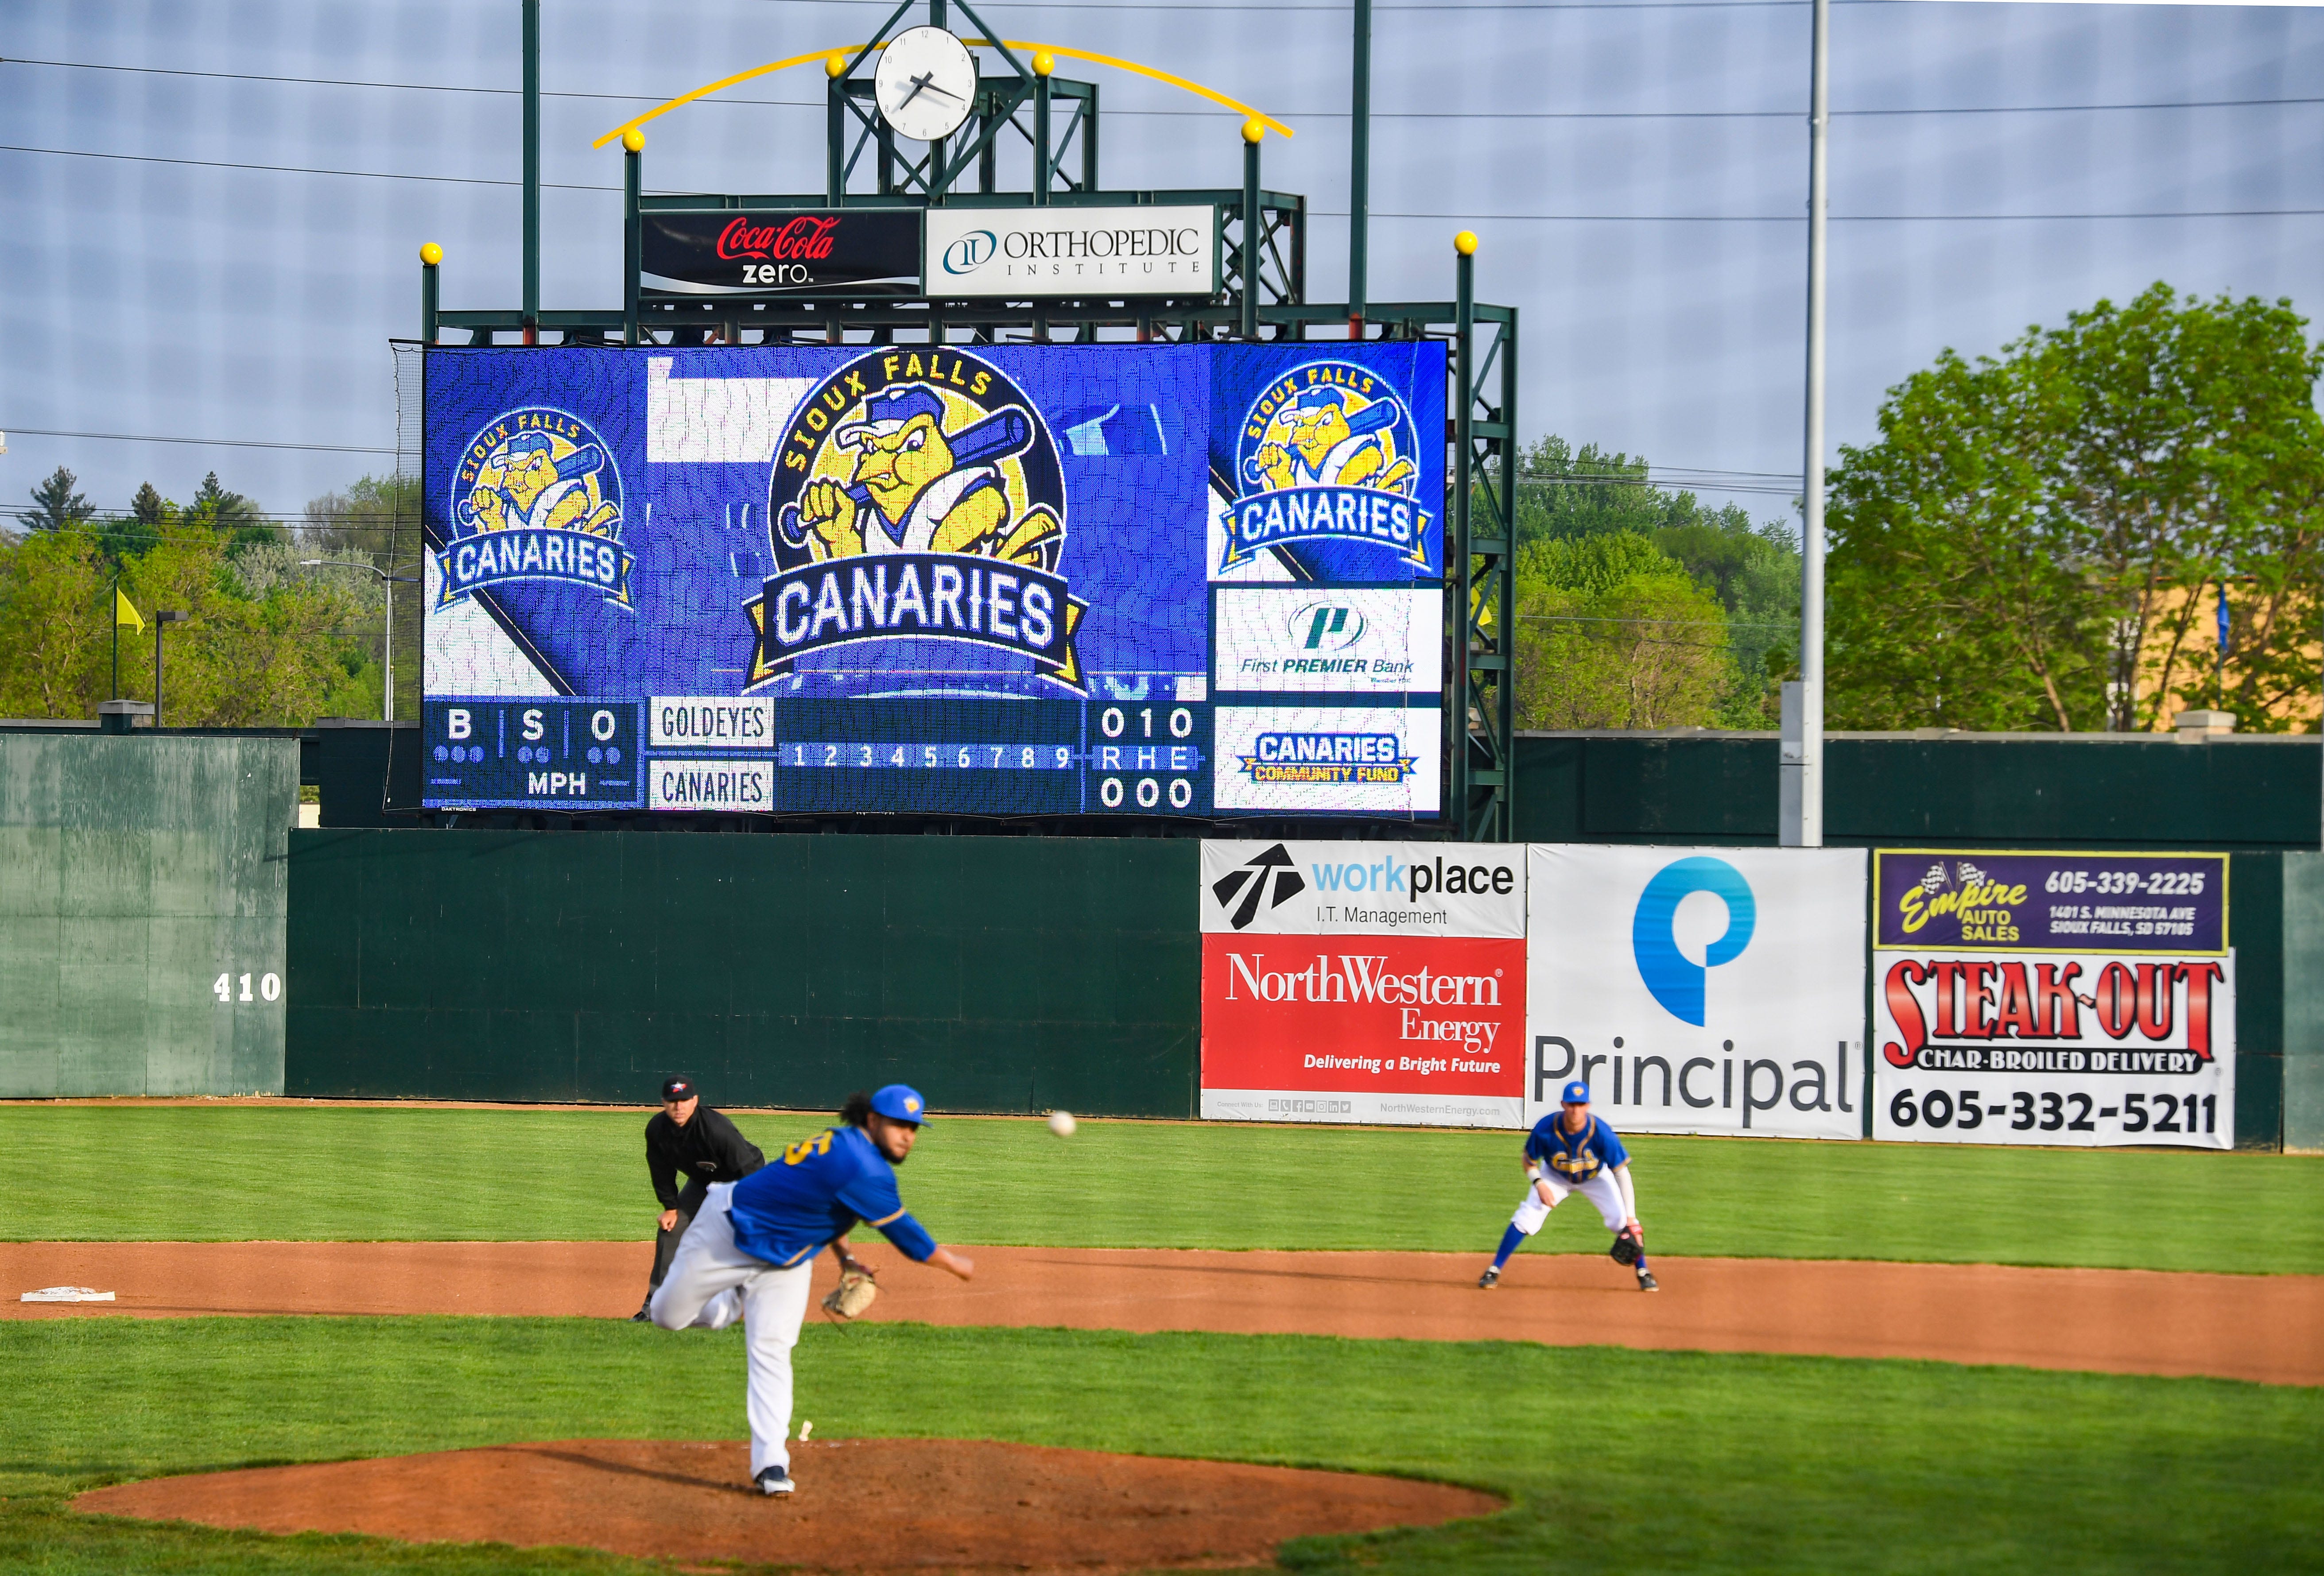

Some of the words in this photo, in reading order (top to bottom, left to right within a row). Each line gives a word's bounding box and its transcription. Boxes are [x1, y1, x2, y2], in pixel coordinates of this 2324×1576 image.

[716, 216, 841, 260] Coca-Cola
[1004, 228, 1199, 258] ORTHOPEDIC
[743, 264, 807, 283] zero
[1007, 262, 1199, 275] INSTITUTE
[785, 370, 866, 472] SIOUX
[884, 353, 992, 396] FALLS
[1248, 377, 1297, 439] SIOUX
[1308, 368, 1374, 393] FALLS
[462, 424, 508, 482] SIOUX
[518, 414, 580, 438] FALLS
[1242, 492, 1410, 542] CANARIES
[456, 535, 615, 583] CANARIES
[774, 563, 1055, 649] CANARIES
[1241, 659, 1277, 673] First
[1282, 659, 1368, 673] PREMIER
[1372, 659, 1414, 673] Bank
[448, 709, 471, 740] B
[522, 709, 544, 740] S
[662, 707, 764, 739] GOLDEYES
[794, 747, 804, 766] 1
[824, 747, 837, 766] 2
[858, 747, 873, 766] 3
[890, 747, 904, 767] 4
[925, 747, 937, 767] 5
[957, 747, 970, 768] 6
[990, 747, 1004, 767] 7
[1021, 747, 1035, 768] 8
[1056, 747, 1069, 769] 9
[1259, 736, 1396, 763] CANARIES
[528, 772, 585, 795] MPH
[662, 772, 763, 802] CANARIES
[1255, 766, 1351, 782] COMMUNITY
[1357, 767, 1398, 782] FUND
[1311, 855, 1514, 902] workplace
[2045, 871, 2206, 895] 605-339-2225
[1317, 906, 1339, 922] I.T.
[1345, 906, 1447, 926] Management
[1899, 879, 2028, 933] Empire
[1962, 910, 2011, 925] AUTO
[2080, 906, 2093, 919] S.
[2094, 906, 2168, 920] MINNESOTA
[2169, 907, 2197, 920] AVE
[1961, 926, 2020, 941] SALES
[2049, 921, 2090, 934] SIOUX
[2135, 922, 2153, 935] SD
[213, 972, 281, 1002] 410
[1399, 1008, 1501, 1053] Energy
[1304, 1054, 1381, 1074] Delivering
[1385, 1059, 1395, 1071] a
[1400, 1057, 1447, 1075] Bright
[1451, 1058, 1501, 1073] Future
[1917, 1049, 2085, 1071] CHAR-BROILED
[2091, 1051, 2198, 1073] DELIVERY
[1535, 1035, 1853, 1129] Principal
[1380, 1103, 1500, 1116] NorthWesternEnergy.com
[1890, 1089, 2216, 1133] 605-332-5211
